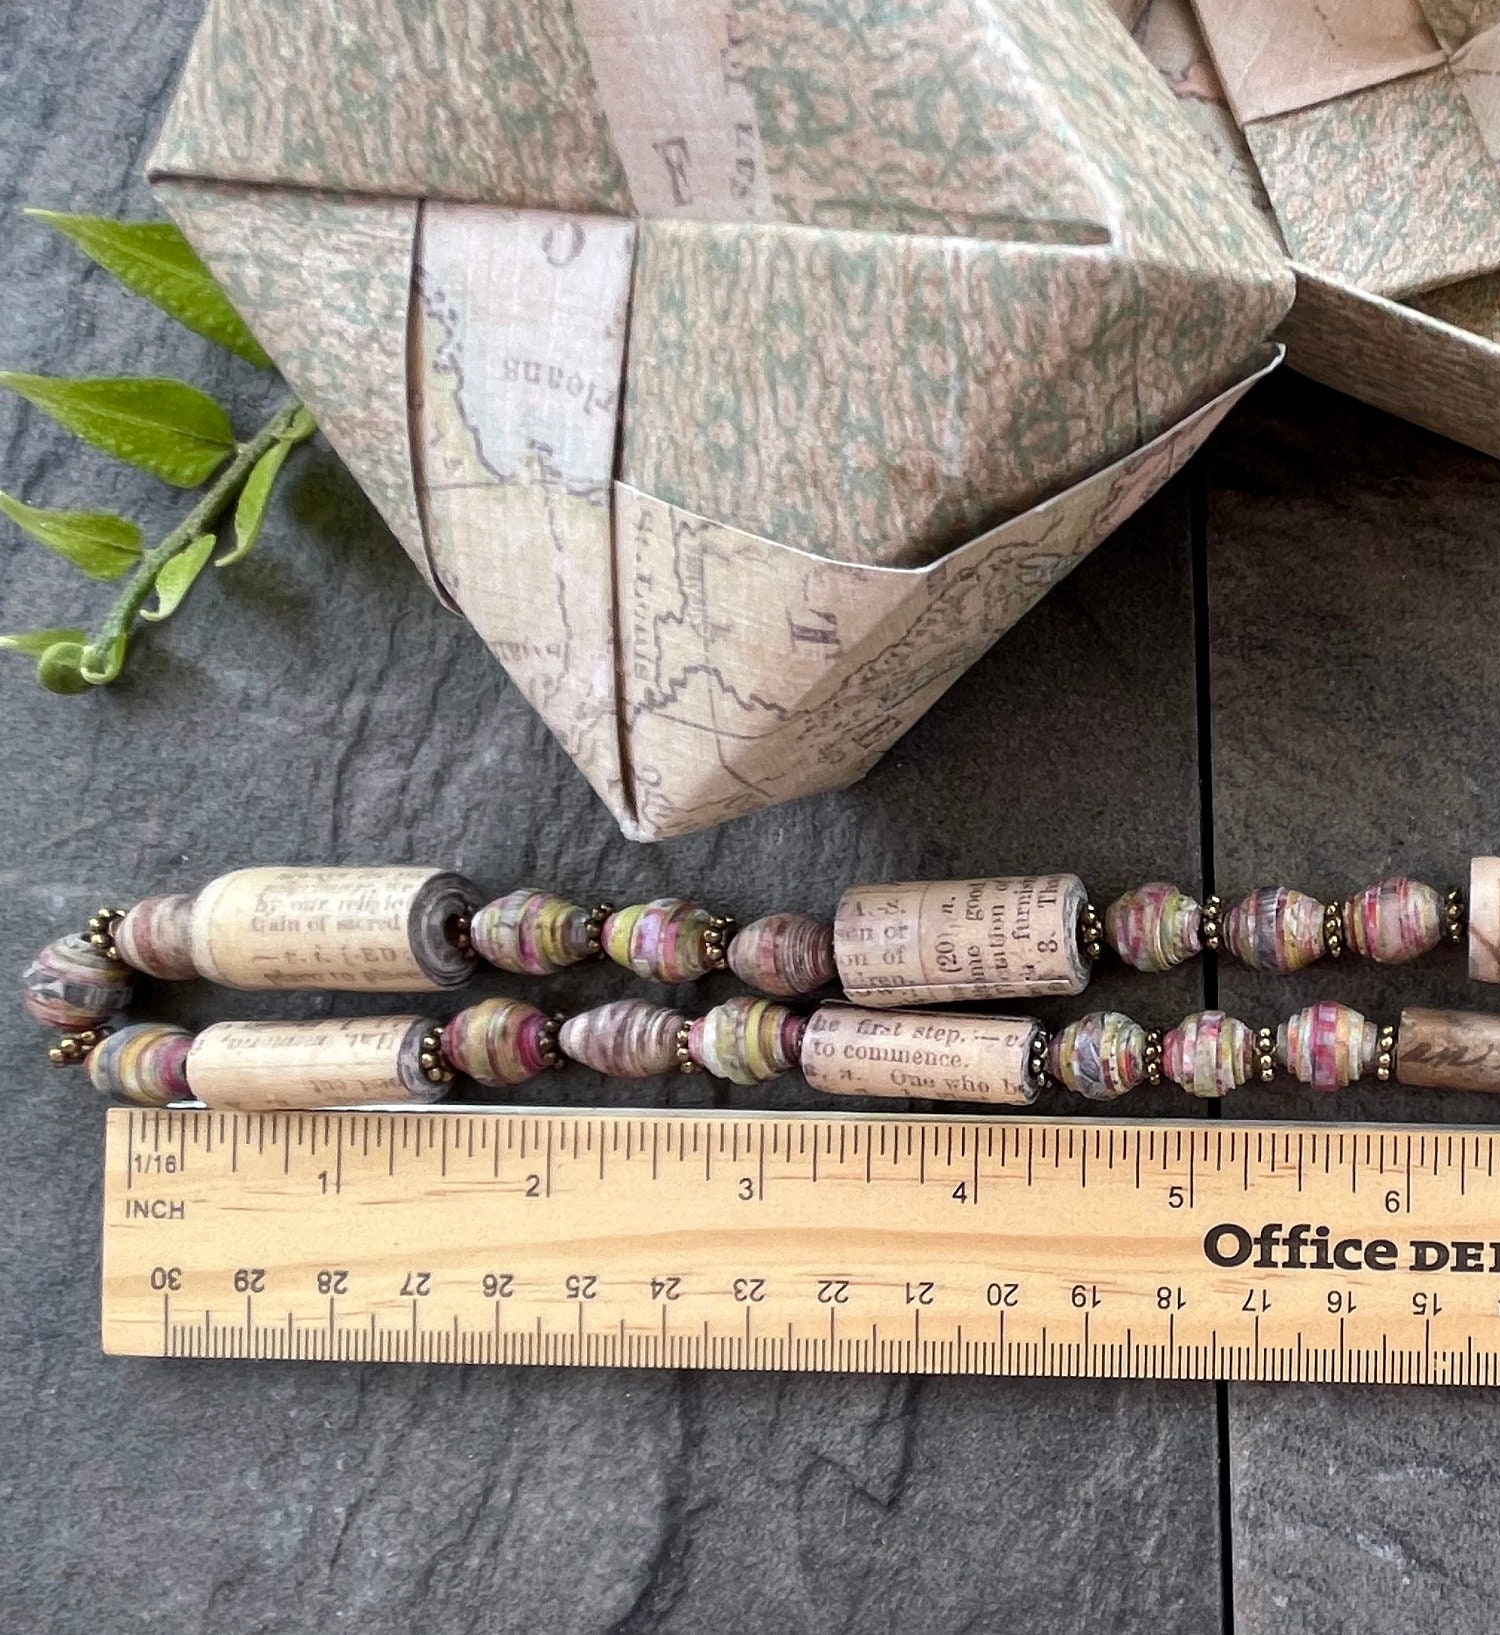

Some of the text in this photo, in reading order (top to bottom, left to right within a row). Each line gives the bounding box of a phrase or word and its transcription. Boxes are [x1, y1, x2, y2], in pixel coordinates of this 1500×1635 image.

[814, 1040, 969, 1068] to commence.
[134, 1153, 177, 1175] 1/16
[317, 1172, 328, 1194] 1
[525, 1175, 540, 1198] 2
[738, 1178, 753, 1200] 3
[952, 1182, 967, 1204] 4
[1169, 1186, 1184, 1209] 5
[1384, 1190, 1400, 1213] 6
[125, 1199, 186, 1220] INCH
[1203, 1223, 1398, 1270] Office
[151, 1266, 182, 1290] 30
[234, 1268, 266, 1292] 29
[317, 1270, 349, 1293] 28
[399, 1272, 432, 1295] 27
[482, 1274, 514, 1297] 26
[565, 1275, 597, 1298] 25
[650, 1276, 681, 1300] 24
[732, 1278, 765, 1301] 23
[817, 1279, 849, 1303] 22
[904, 1281, 934, 1304] 21
[986, 1283, 1019, 1305] 20
[1070, 1284, 1101, 1307] 19
[1157, 1286, 1186, 1310] 18
[1241, 1289, 1270, 1311] 17
[1327, 1291, 1356, 1313] 16
[1412, 1292, 1442, 1316] 15
